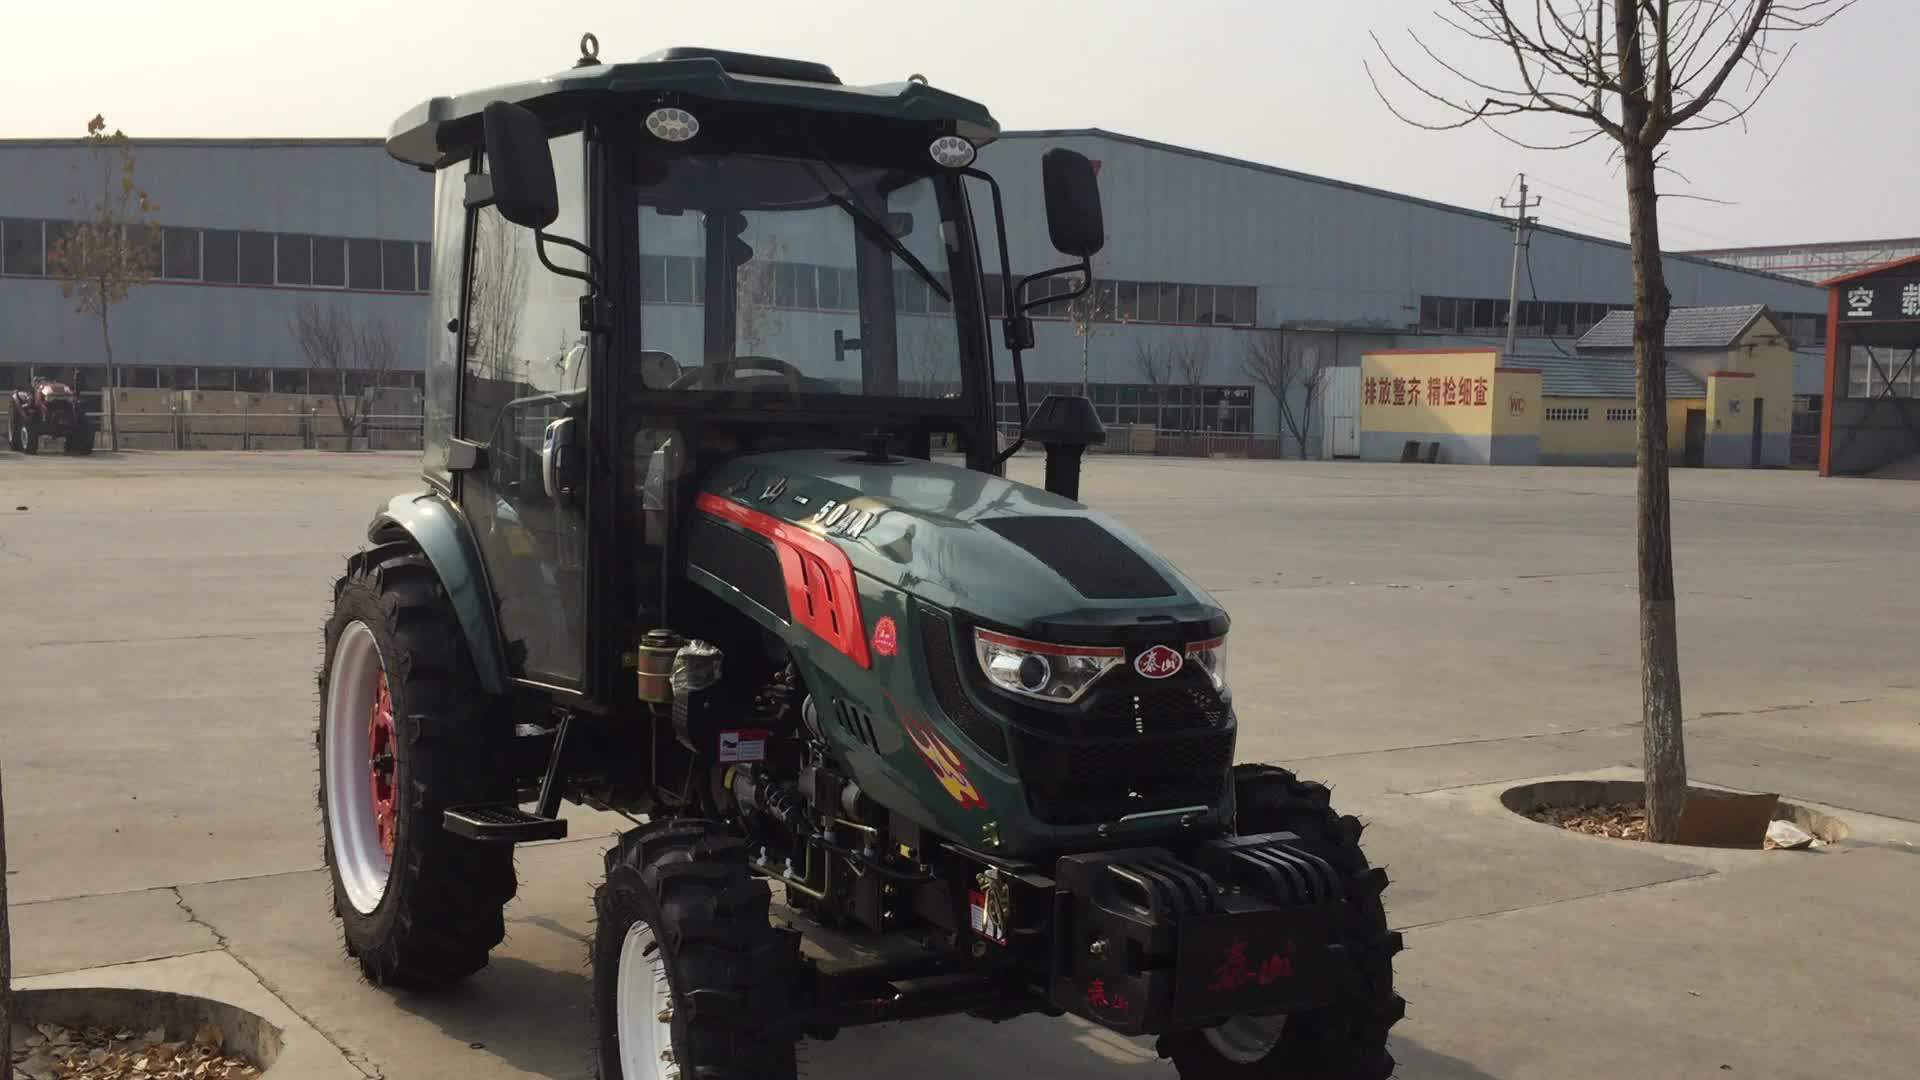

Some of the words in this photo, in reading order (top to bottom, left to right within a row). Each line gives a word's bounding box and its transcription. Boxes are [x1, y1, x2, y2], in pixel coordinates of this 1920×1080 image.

[1365, 376, 1421, 406] 排放整齐
[1427, 376, 1488, 406] 精检细查
[1141, 651, 1176, 672] 泰山
